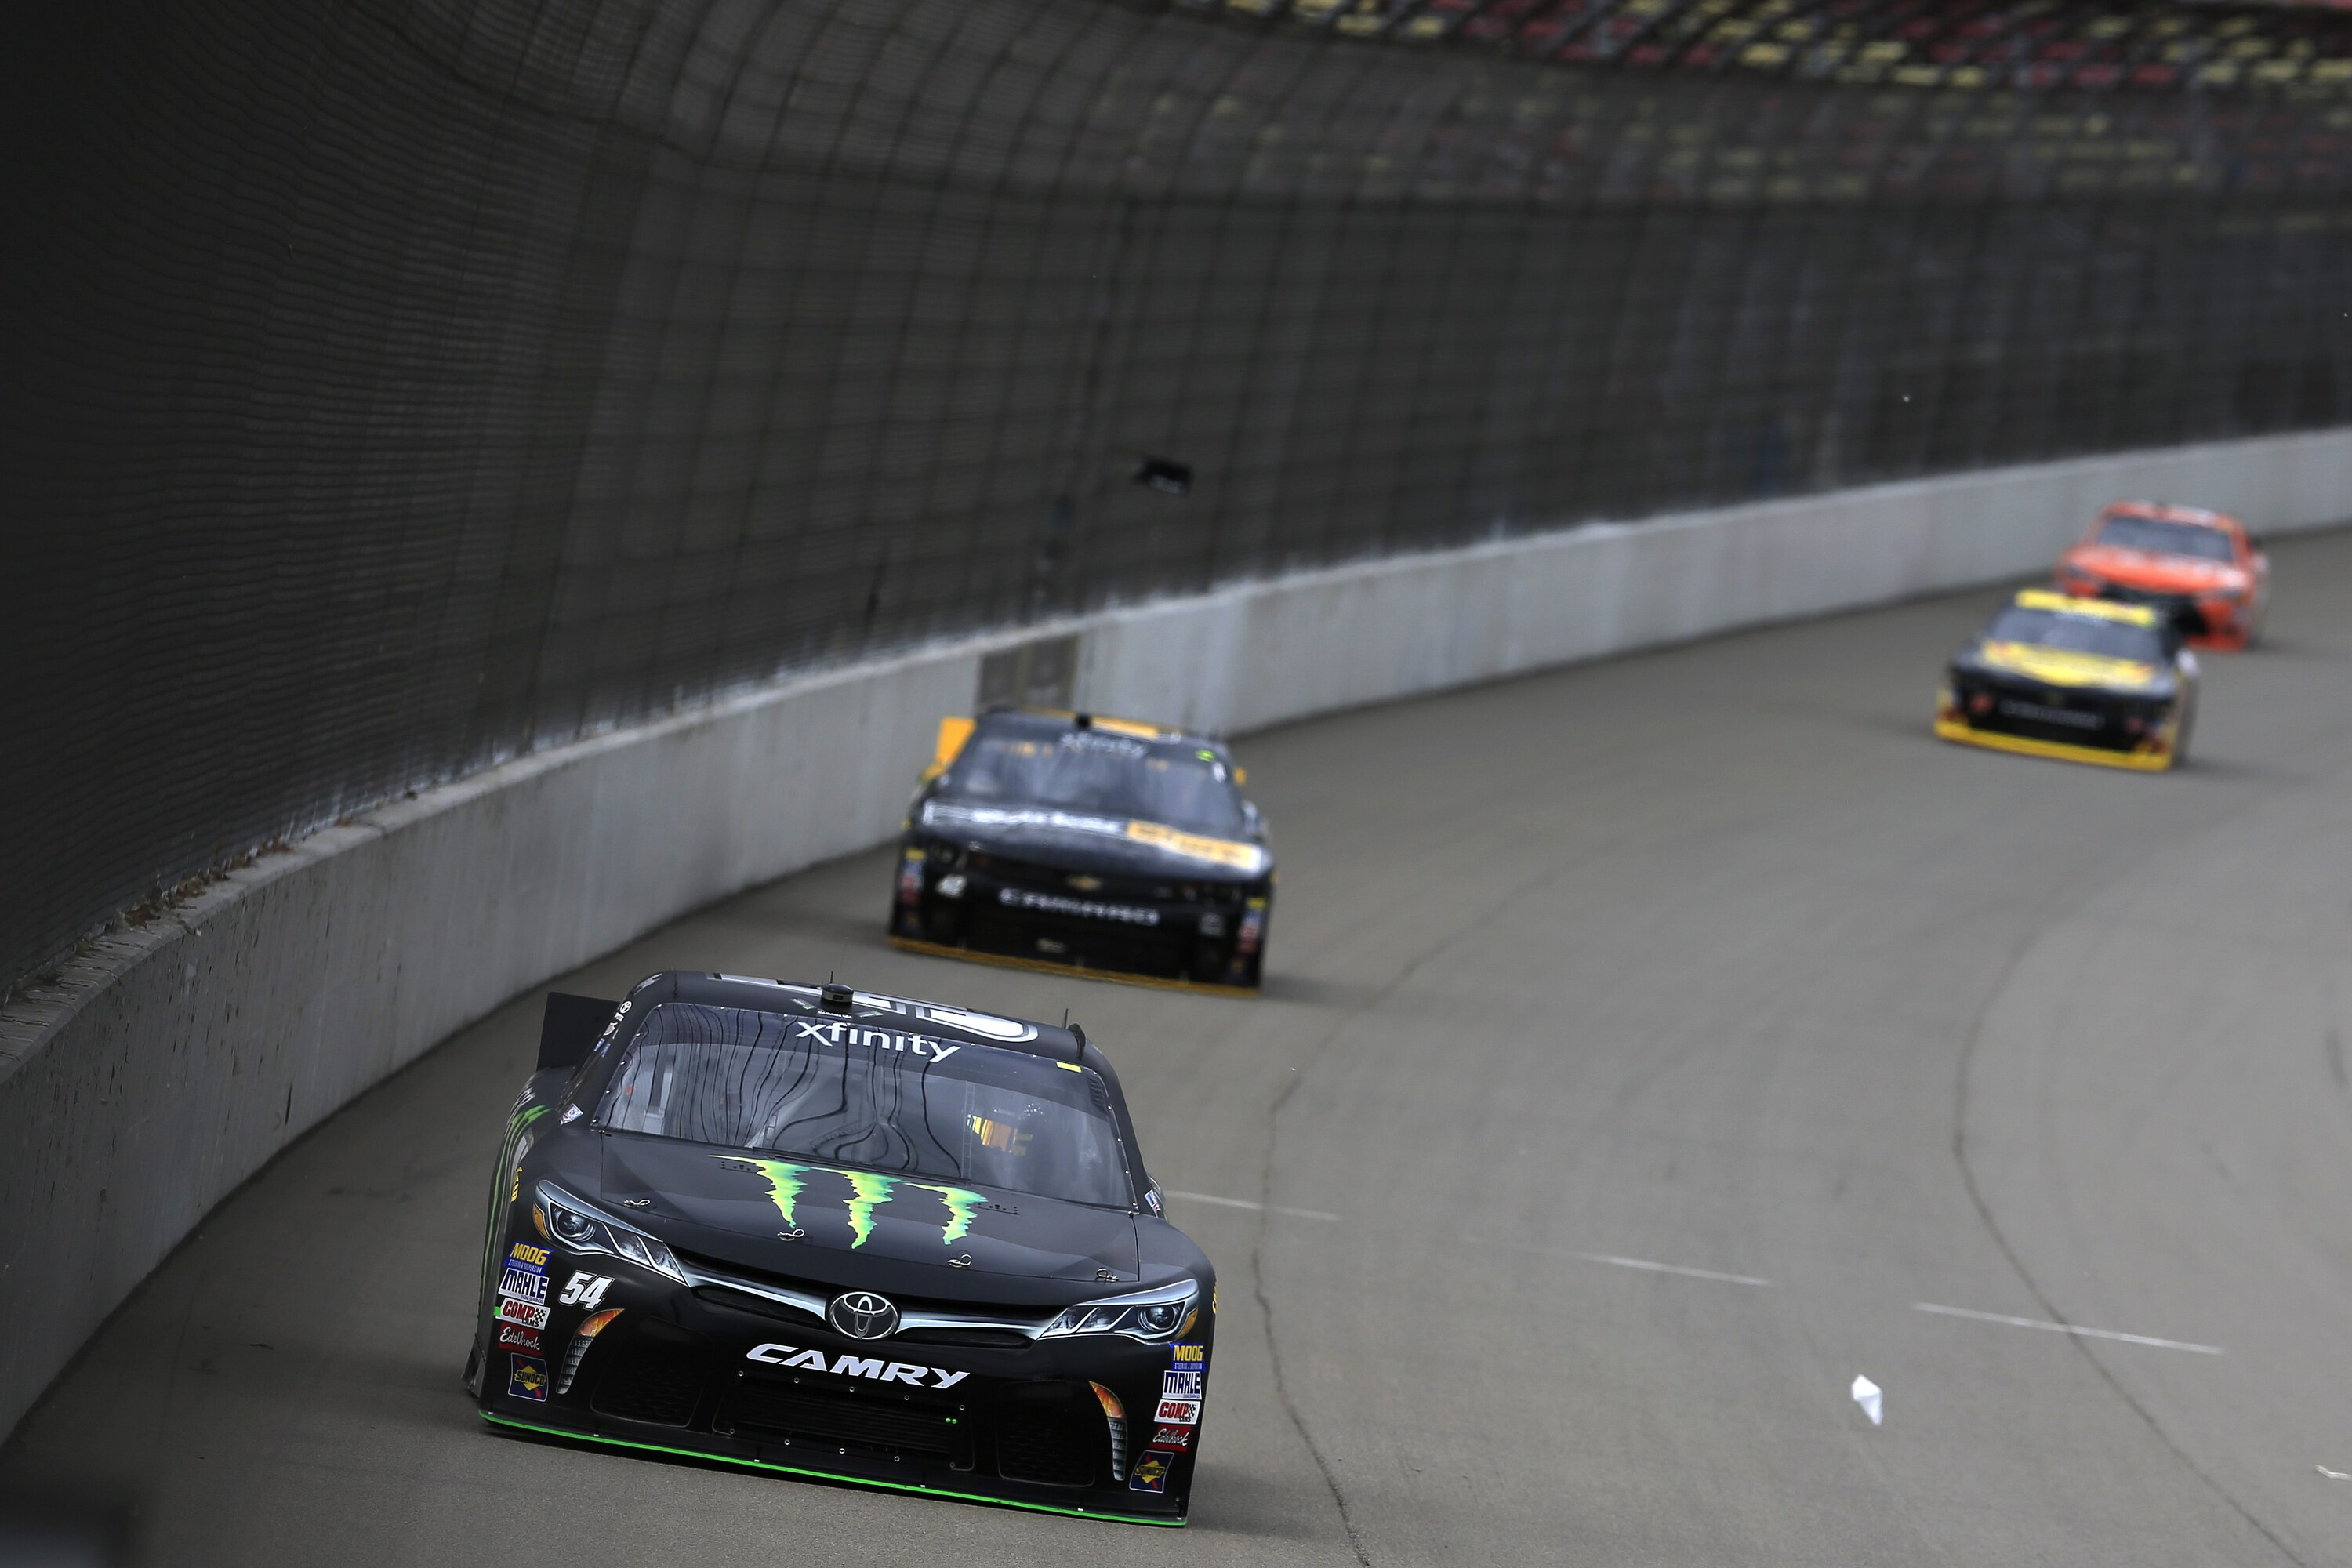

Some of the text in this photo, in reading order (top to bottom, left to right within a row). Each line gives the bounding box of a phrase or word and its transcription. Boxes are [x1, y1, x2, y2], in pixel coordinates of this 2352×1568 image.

[796, 1022, 961, 1063] xfinity
[510, 1243, 550, 1266] MOOG
[502, 1269, 549, 1299] MAHLE
[559, 1271, 615, 1309] 54
[502, 1301, 535, 1319] COMP
[521, 1318, 540, 1327] CAMS
[499, 1326, 541, 1351] Edelbrock
[1173, 1345, 1203, 1361] MOOG
[746, 1343, 971, 1389] CAMRY
[516, 1370, 546, 1386] SUNOCO
[1163, 1372, 1200, 1394] MAHLE
[1158, 1402, 1189, 1419] COMP
